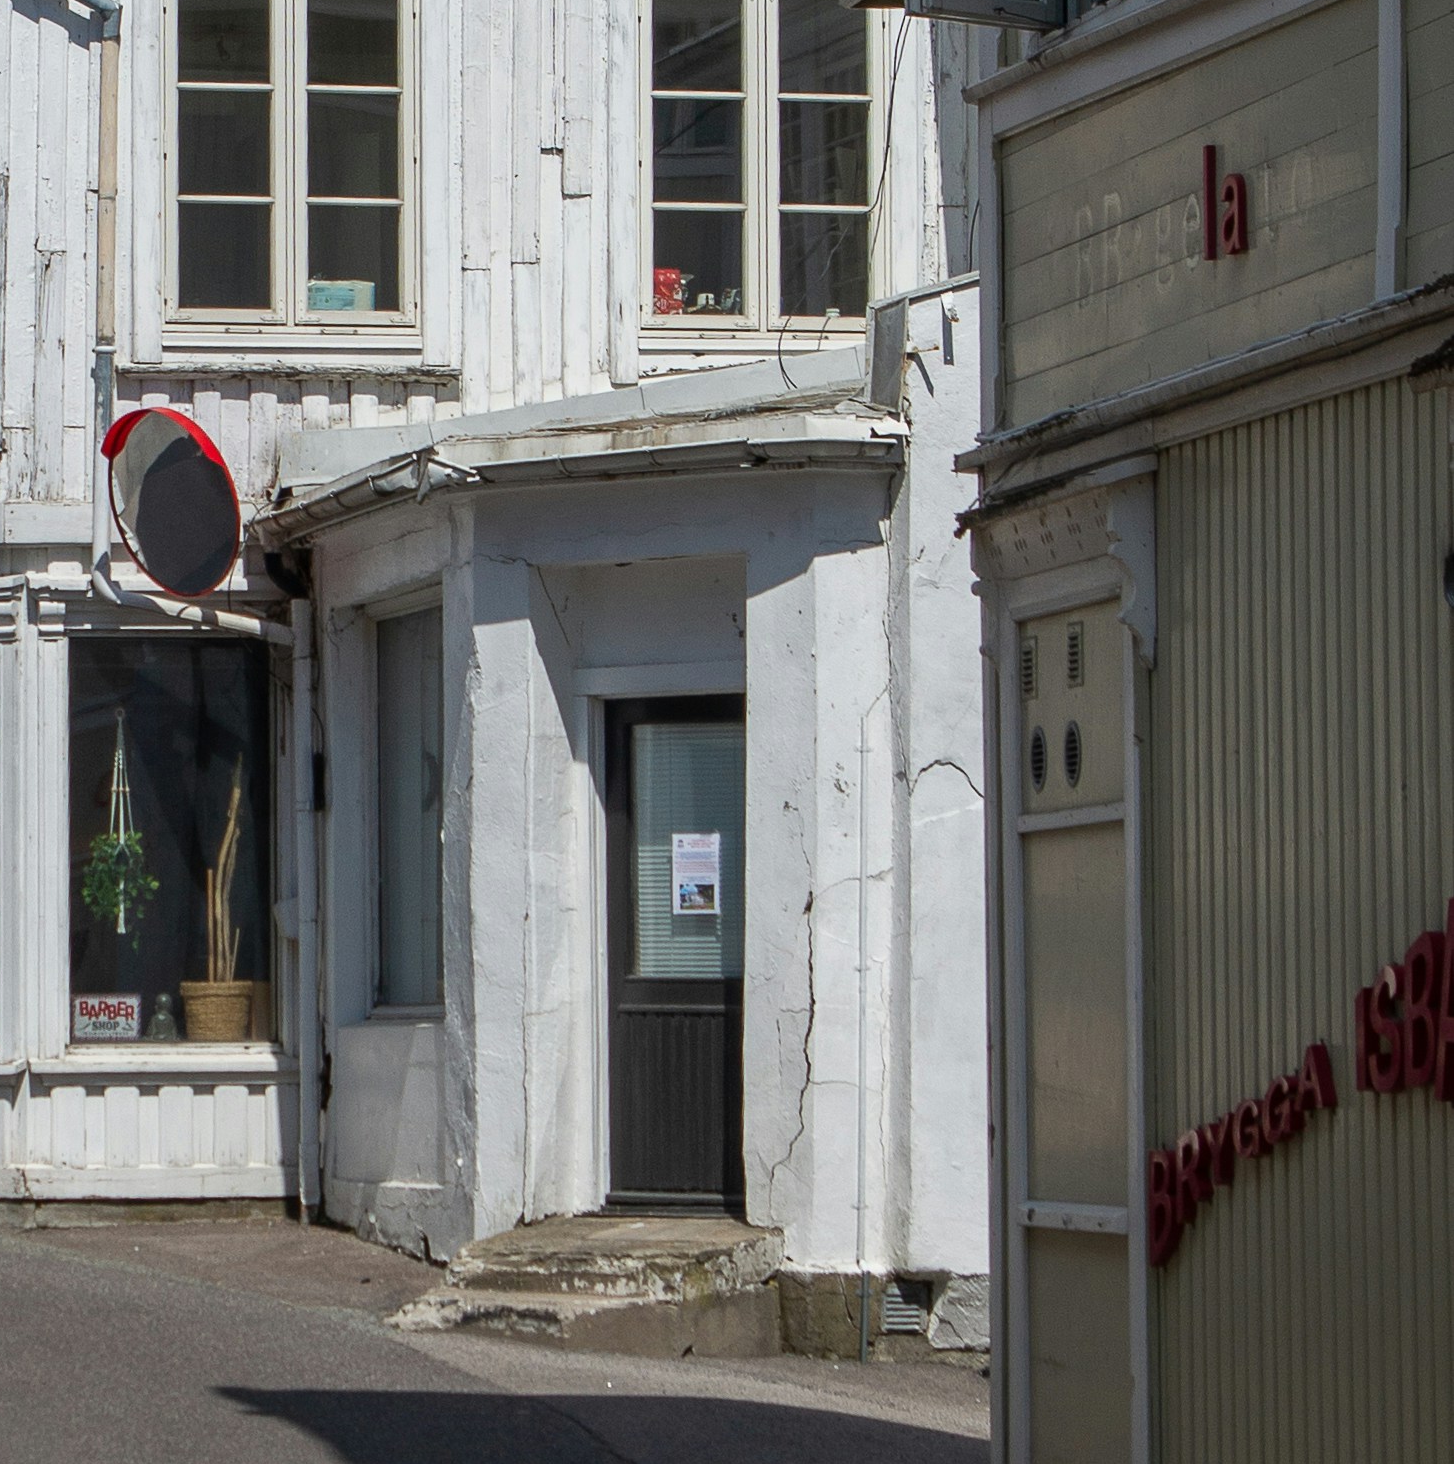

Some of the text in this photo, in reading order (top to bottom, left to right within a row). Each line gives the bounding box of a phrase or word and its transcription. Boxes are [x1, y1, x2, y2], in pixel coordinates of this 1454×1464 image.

[79, 1001, 135, 1021] BARBER
[91, 1021, 120, 1031] SHOP
[1148, 1042, 1337, 1268] BRYGGA
